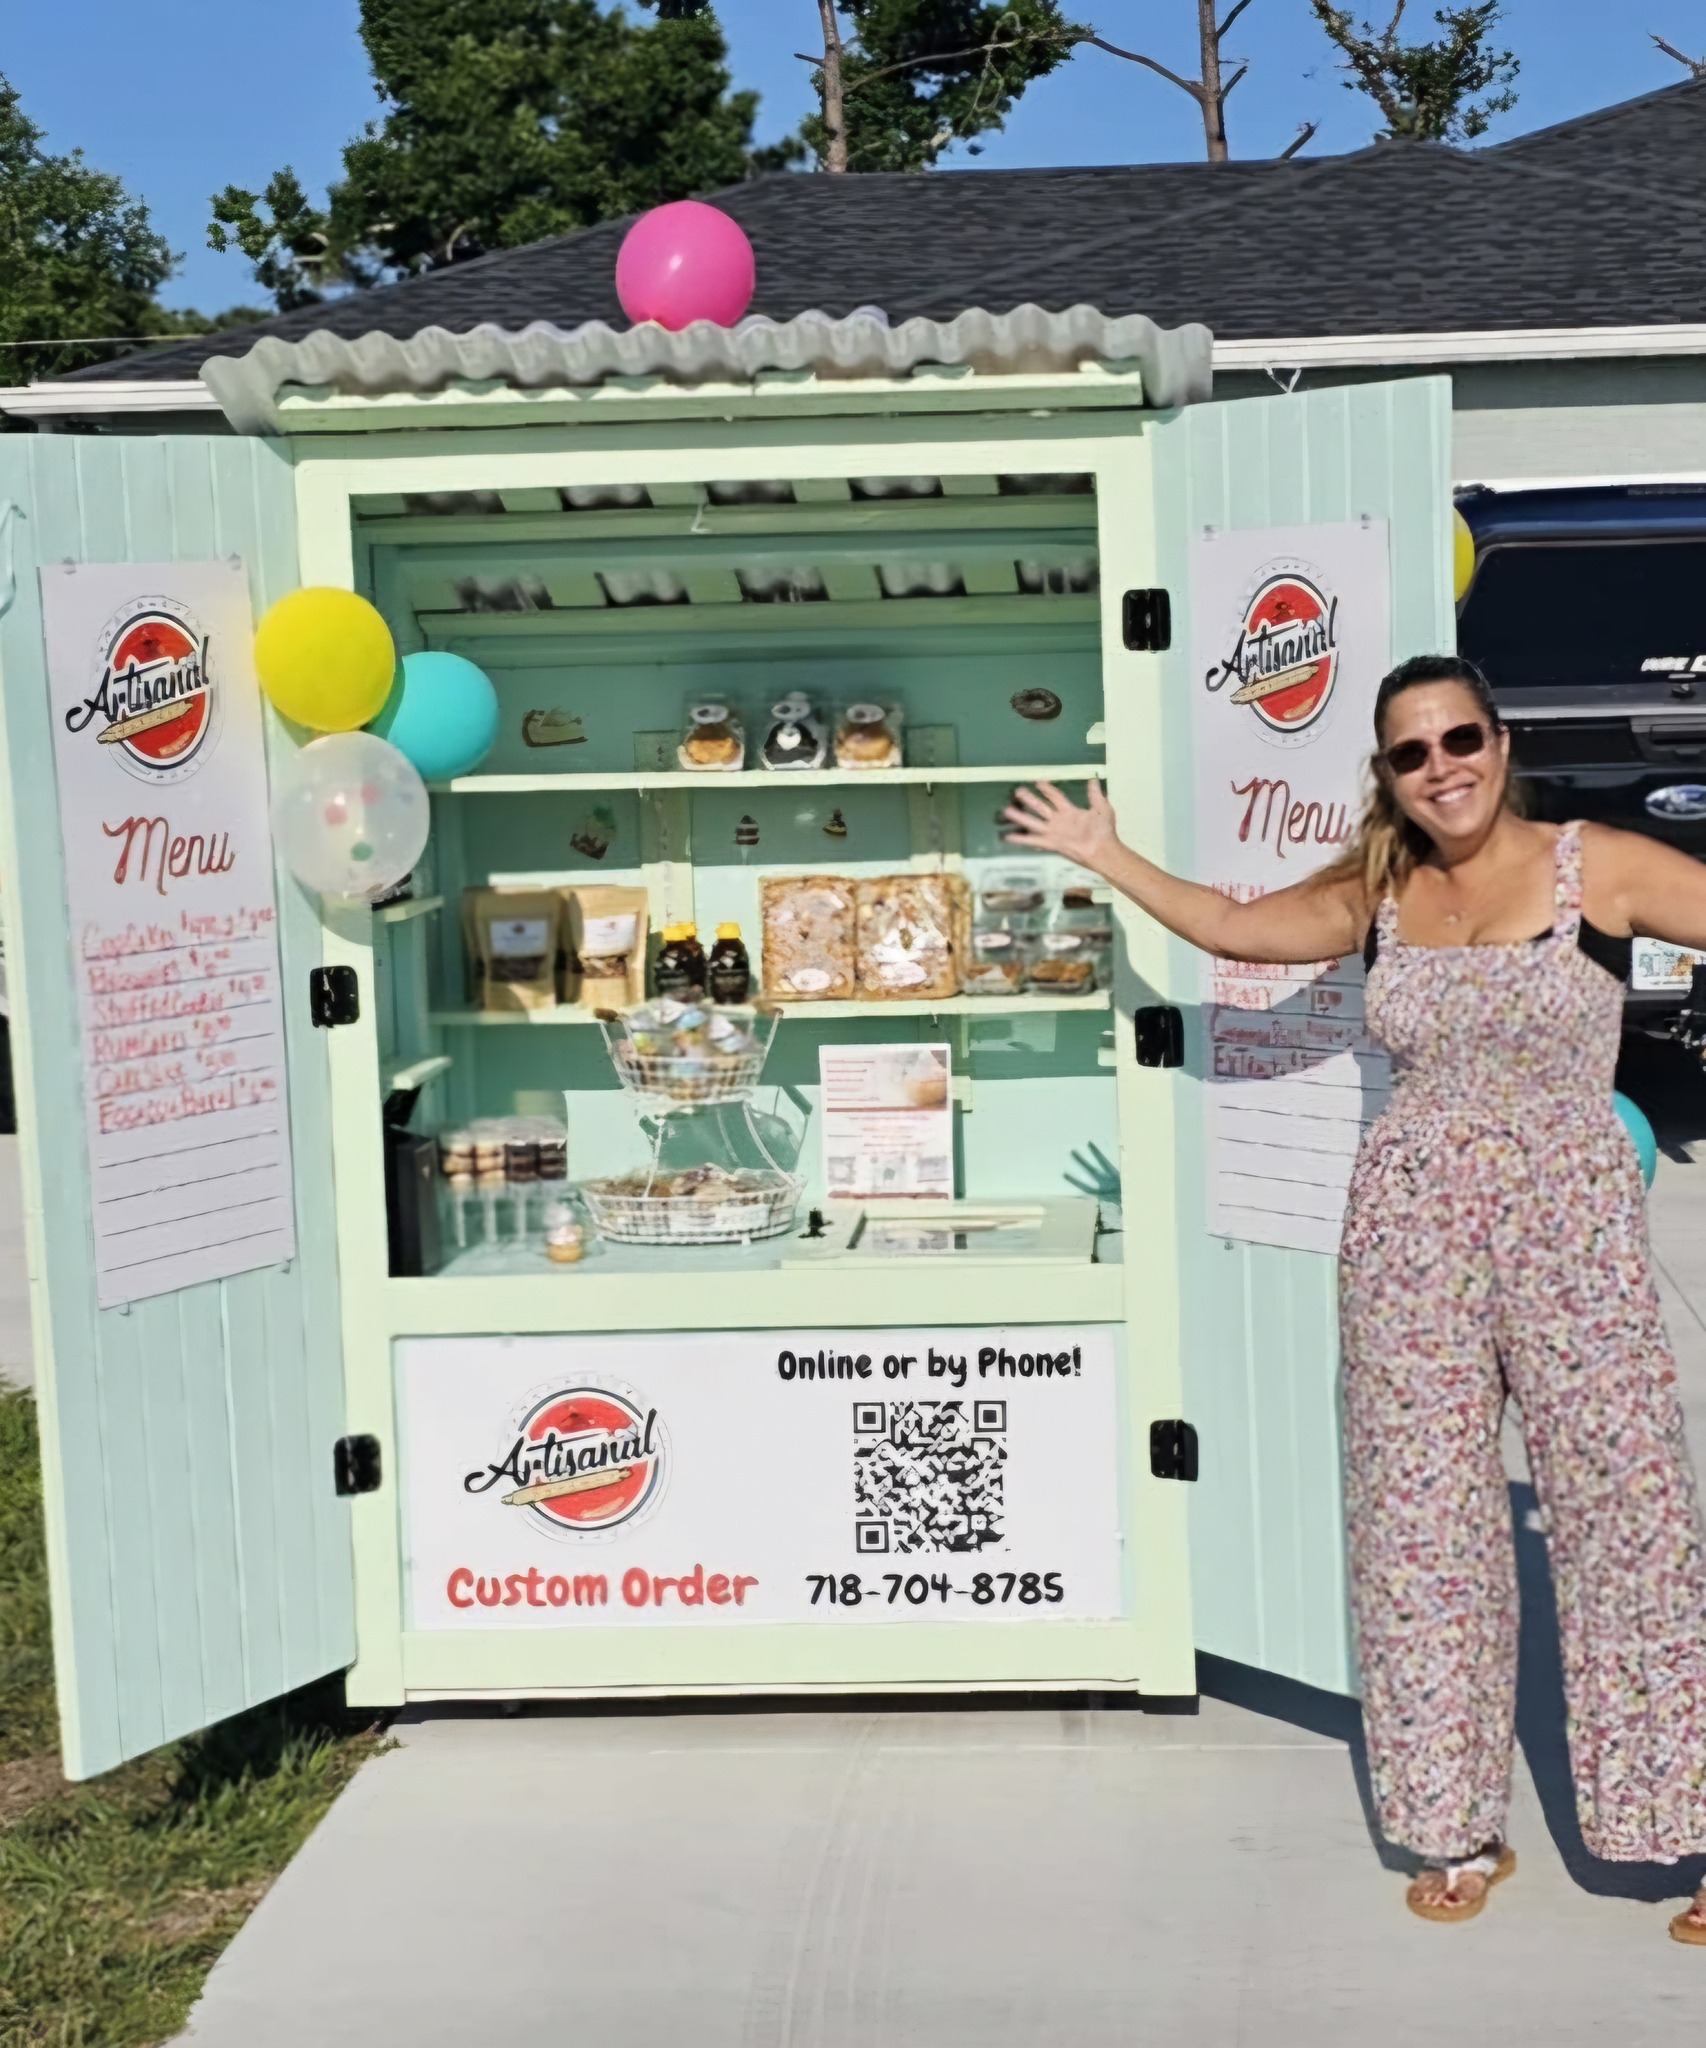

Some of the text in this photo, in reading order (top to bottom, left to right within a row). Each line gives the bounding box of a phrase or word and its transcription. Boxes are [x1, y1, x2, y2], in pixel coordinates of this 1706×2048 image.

[64, 635, 210, 733] Artisanal
[1205, 596, 1339, 692] Artisanal
[102, 816, 236, 896] Menu
[1231, 776, 1352, 860] Menu
[777, 1346, 1083, 1388] Online or by Phone!
[464, 1407, 657, 1494] Artisanal
[447, 1564, 758, 1610] Custom Order
[805, 1572, 1065, 1606] 718-704-8785
